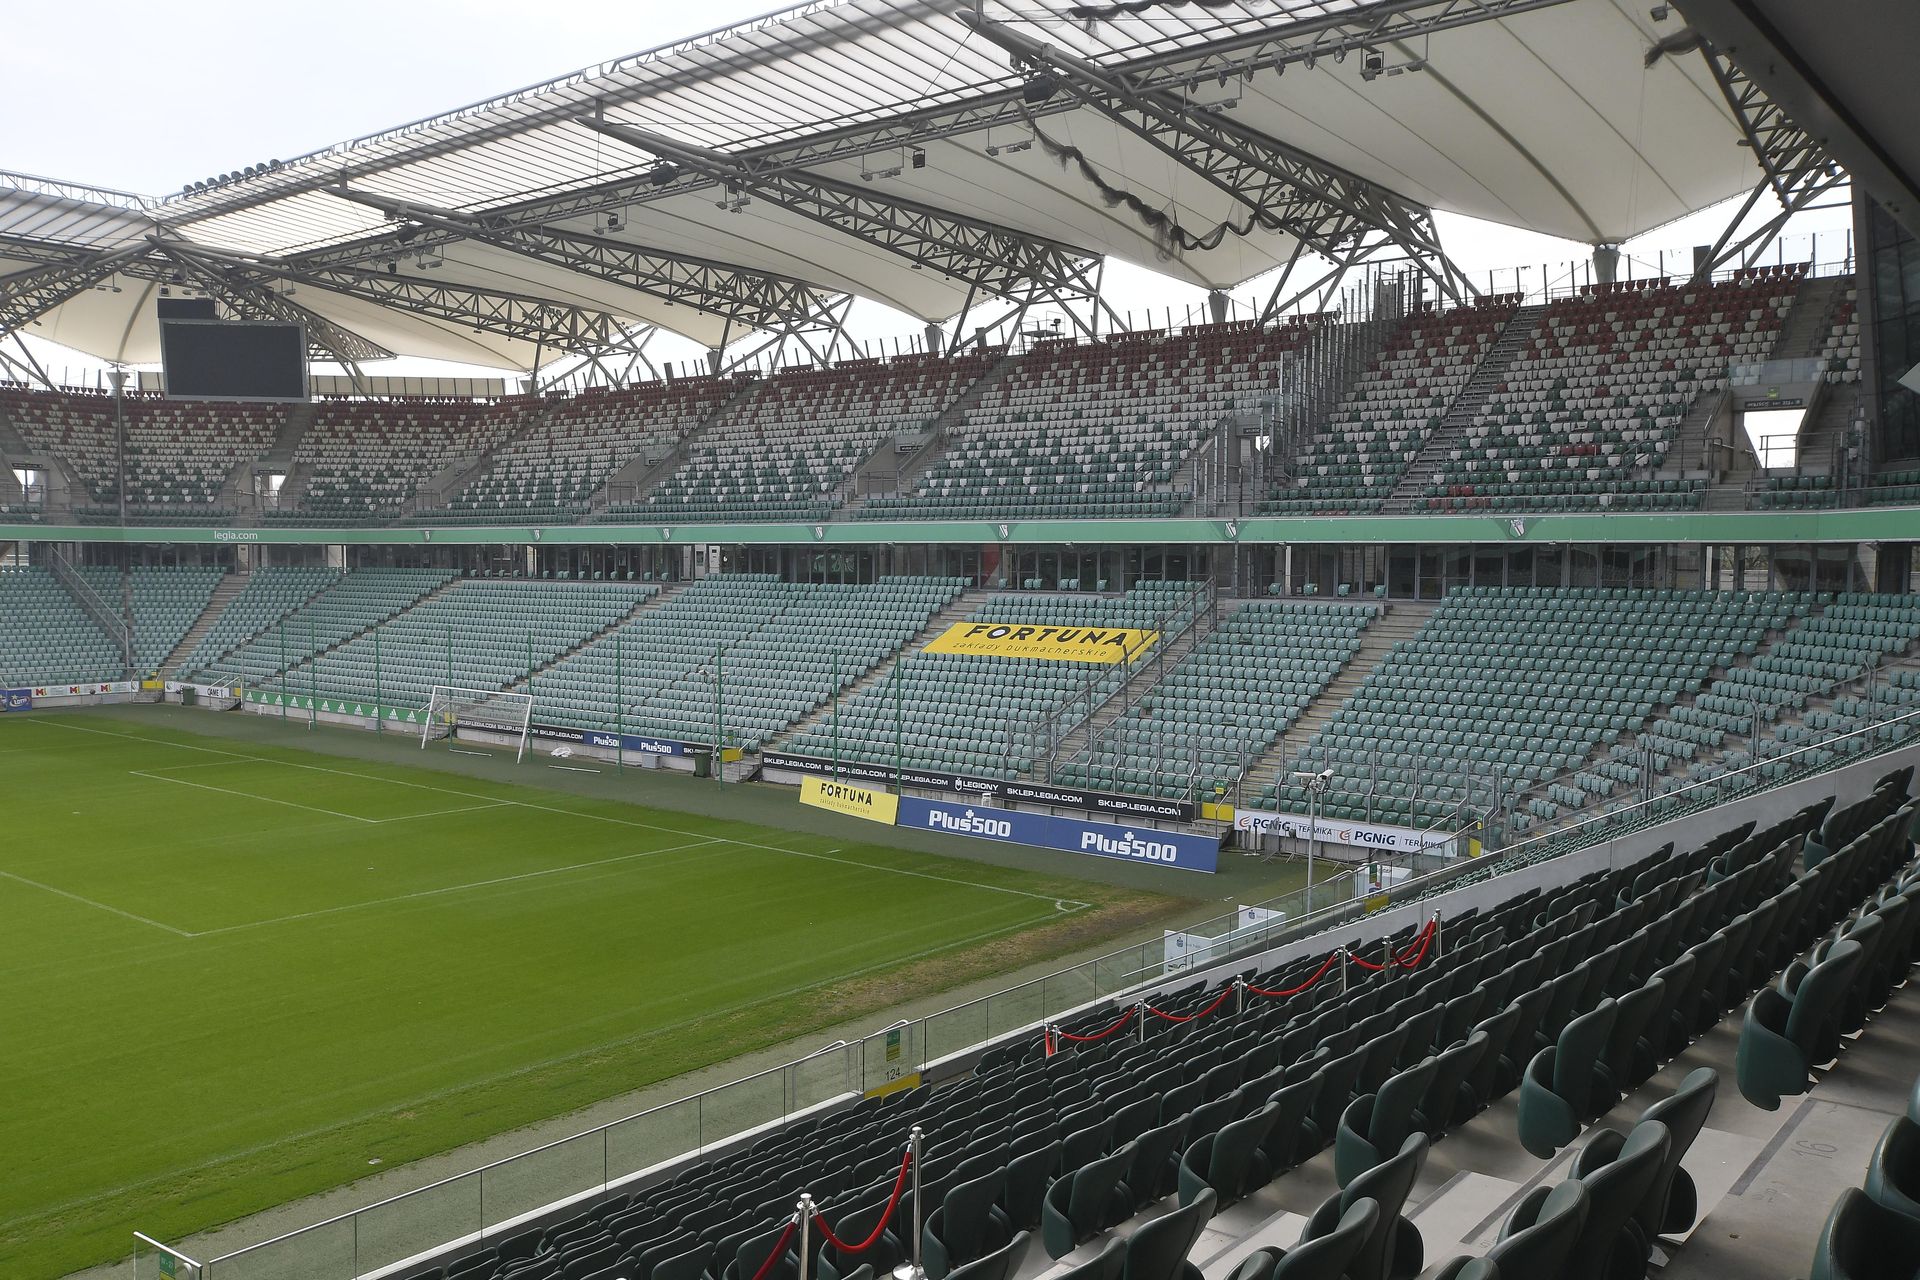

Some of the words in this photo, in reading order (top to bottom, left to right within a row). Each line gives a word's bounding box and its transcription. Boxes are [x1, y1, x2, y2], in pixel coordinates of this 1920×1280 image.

[214, 530, 258, 541] legia.com
[964, 624, 1128, 646] FORTUNA
[539, 729, 583, 740] SKLEP.LEGIA.COM
[641, 741, 672, 754] Plus500
[763, 757, 822, 770] SKLEP.LEGIA.COM
[824, 764, 887, 778] SKEP.LEGIA.COM
[820, 782, 873, 806] FORTUNA
[962, 780, 999, 791] LEGIONY
[1006, 787, 1083, 804] SKLEP.LEGIA.COM
[1097, 799, 1182, 816] SKLEP.LEGIA.COM
[928, 809, 1011, 837] Plus500
[1080, 831, 1177, 862] Plus500
[1252, 817, 1291, 832] PGNiG
[1354, 830, 1397, 846] PGNiG
[885, 1066, 901, 1081] 124
